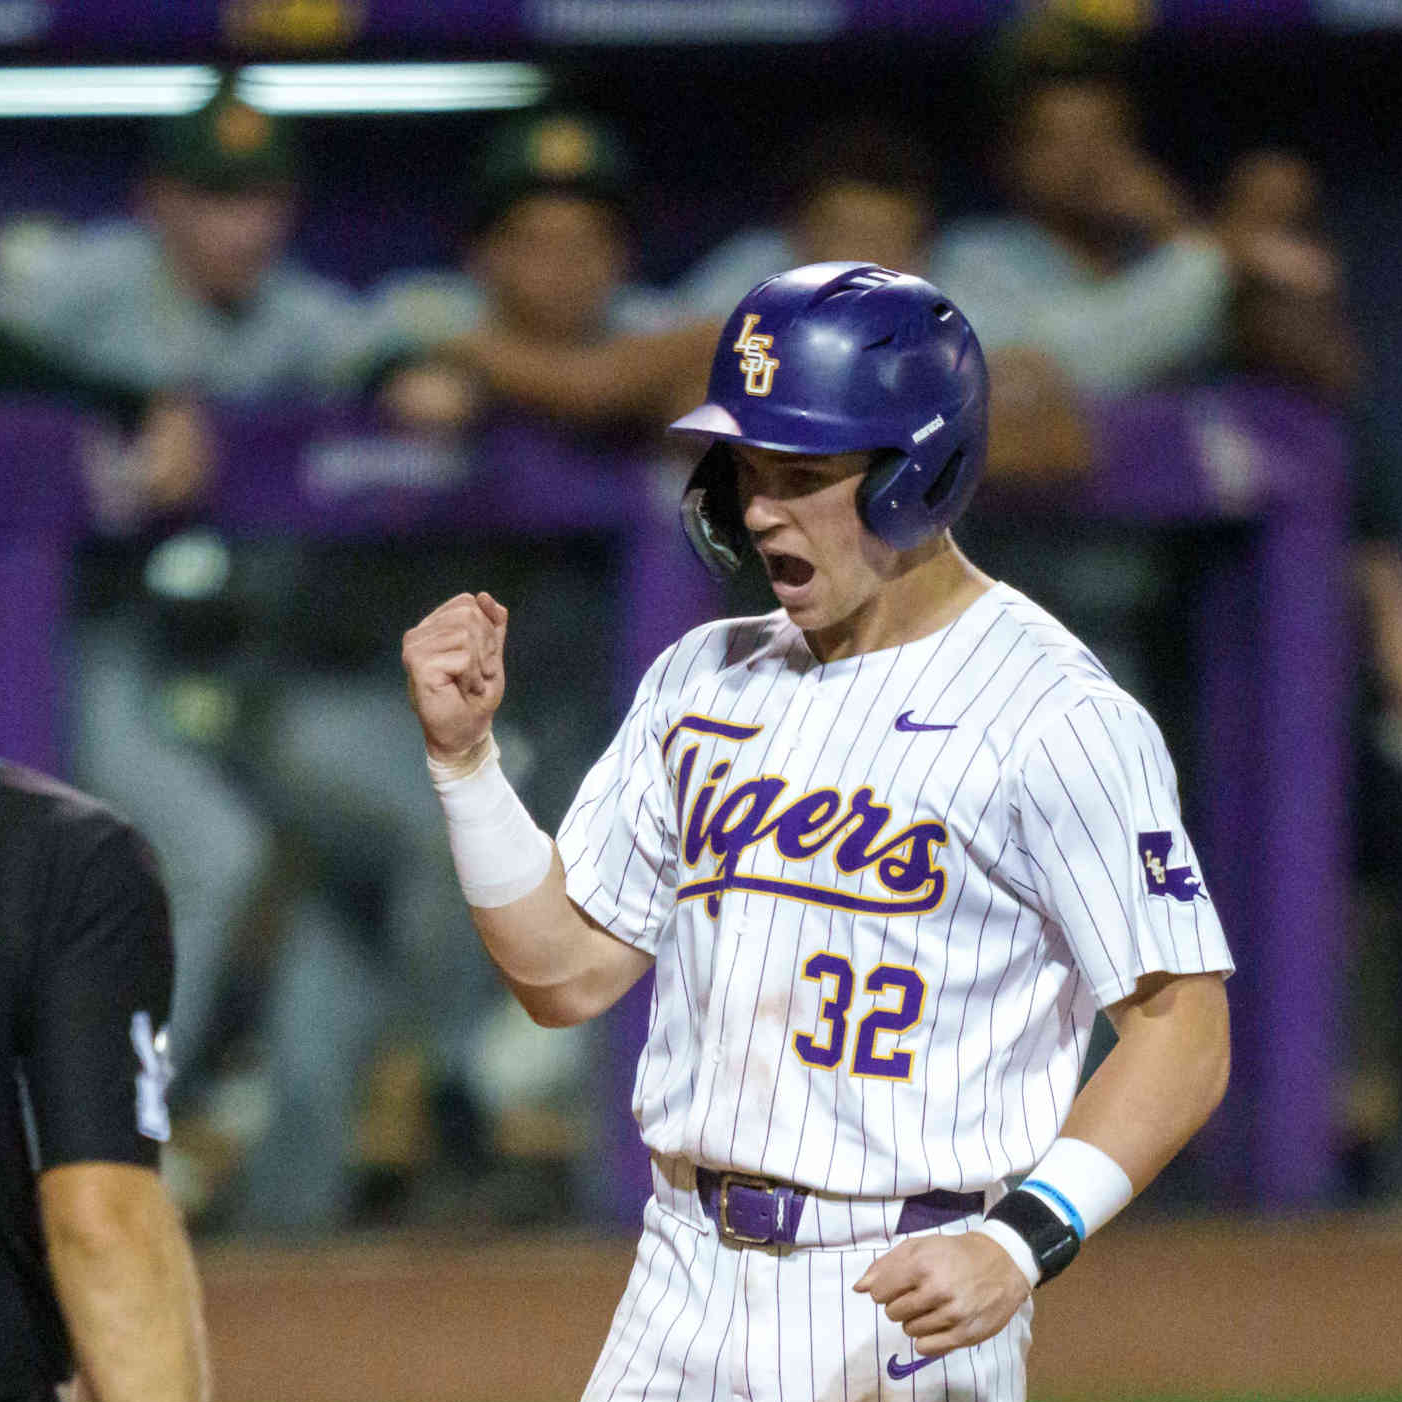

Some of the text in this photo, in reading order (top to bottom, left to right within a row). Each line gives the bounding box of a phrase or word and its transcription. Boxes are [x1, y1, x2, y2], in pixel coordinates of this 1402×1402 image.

[733, 313, 780, 397] LSU
[661, 712, 950, 920] Tigers
[792, 950, 928, 1084] 32
